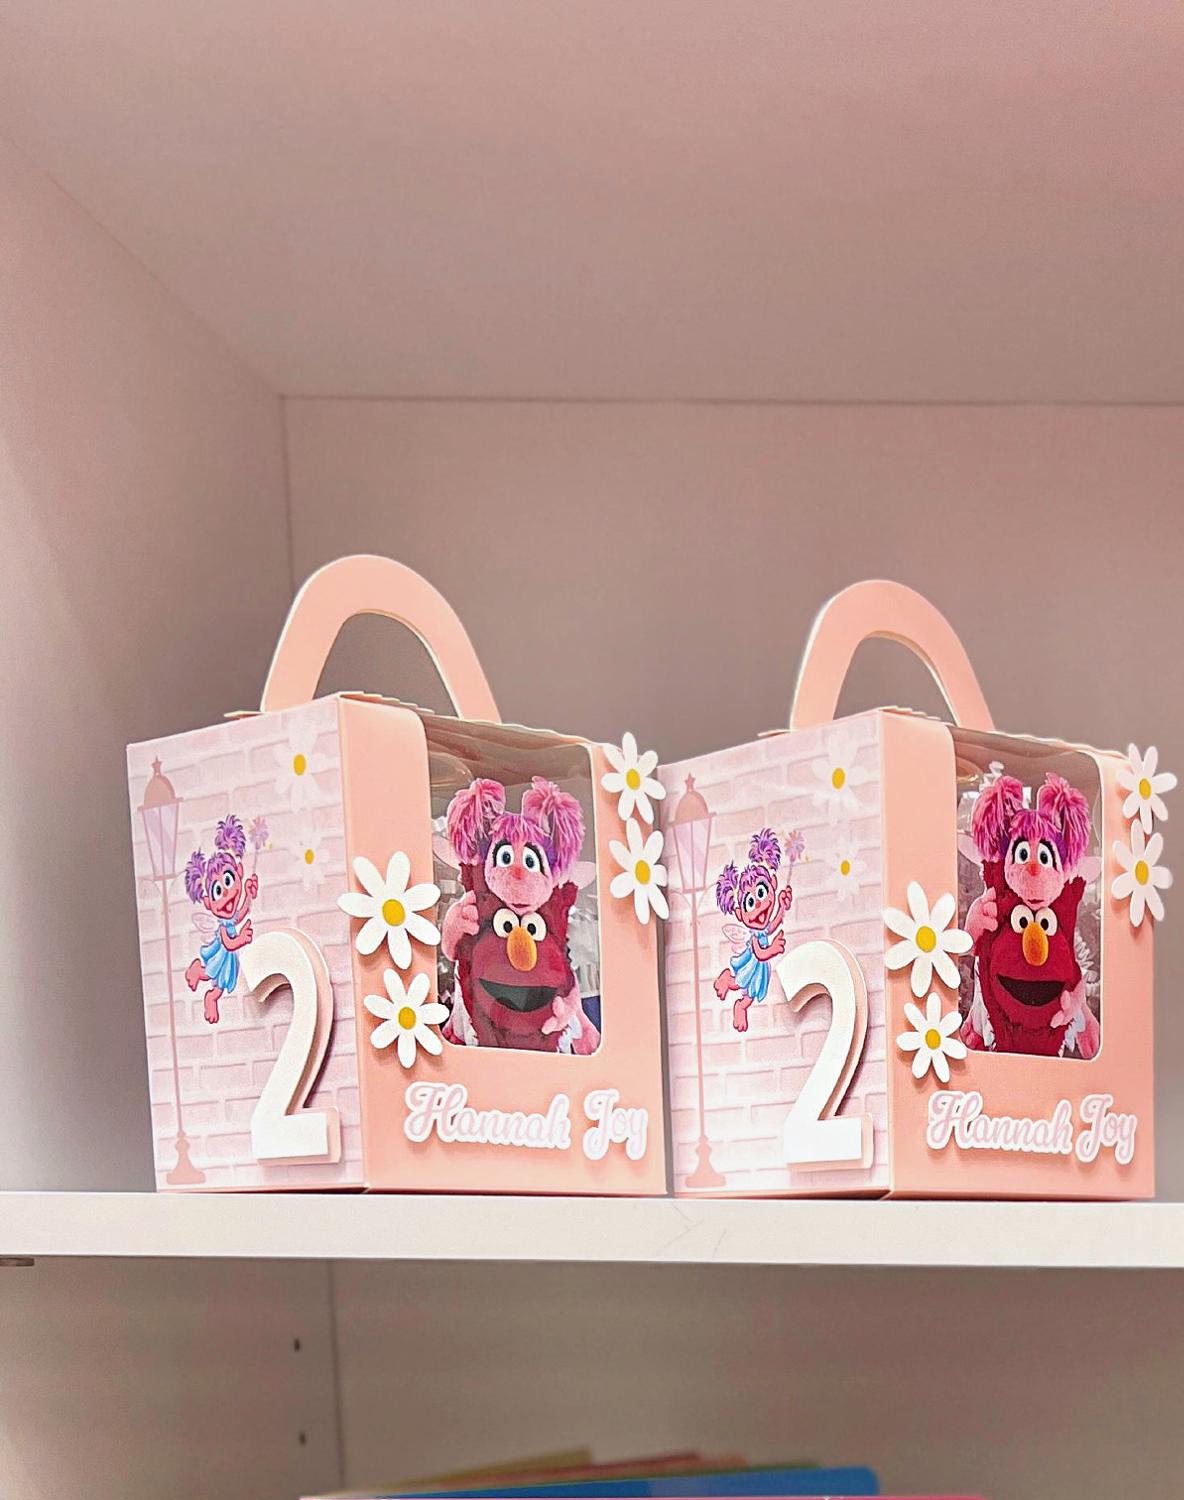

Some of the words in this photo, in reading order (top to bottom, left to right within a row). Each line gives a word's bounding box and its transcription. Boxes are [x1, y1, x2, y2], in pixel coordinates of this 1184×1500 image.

[241, 930, 335, 1160] 2
[404, 1081, 571, 1149] Hannah
[583, 1089, 648, 1160] Joy
[779, 939, 868, 1166] 2
[927, 1090, 1073, 1157] Hannah
[1076, 1094, 1138, 1164] Joy
